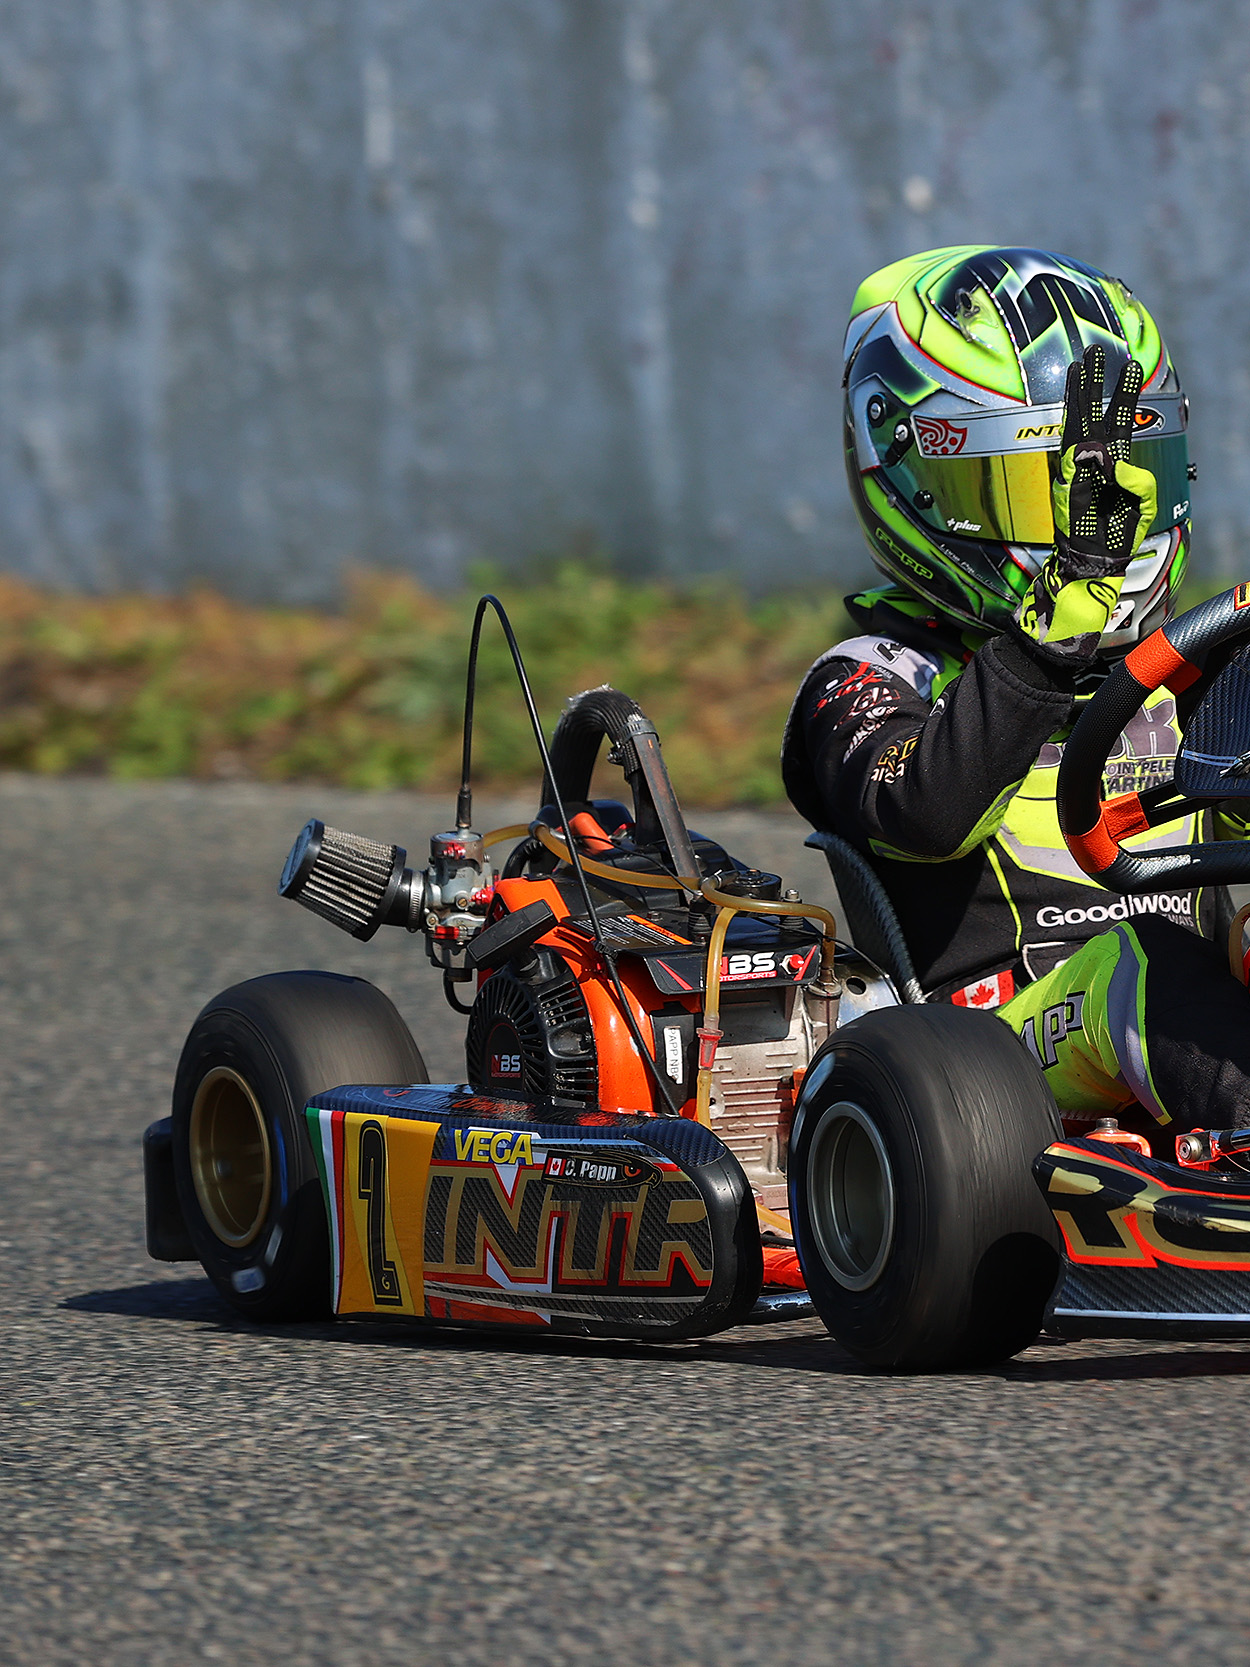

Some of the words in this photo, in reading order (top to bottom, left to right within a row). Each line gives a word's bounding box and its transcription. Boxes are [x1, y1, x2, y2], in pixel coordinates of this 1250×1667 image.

[1014, 423, 1064, 440] INT
[1035, 891, 1193, 928] Goodwood
[720, 970, 777, 982] OTORSPORTS
[1020, 990, 1087, 1072] APP
[490, 1054, 521, 1072] NBS
[454, 1129, 534, 1166] VEGA
[581, 1161, 617, 1182] Papp
[358, 1119, 404, 1307] 2
